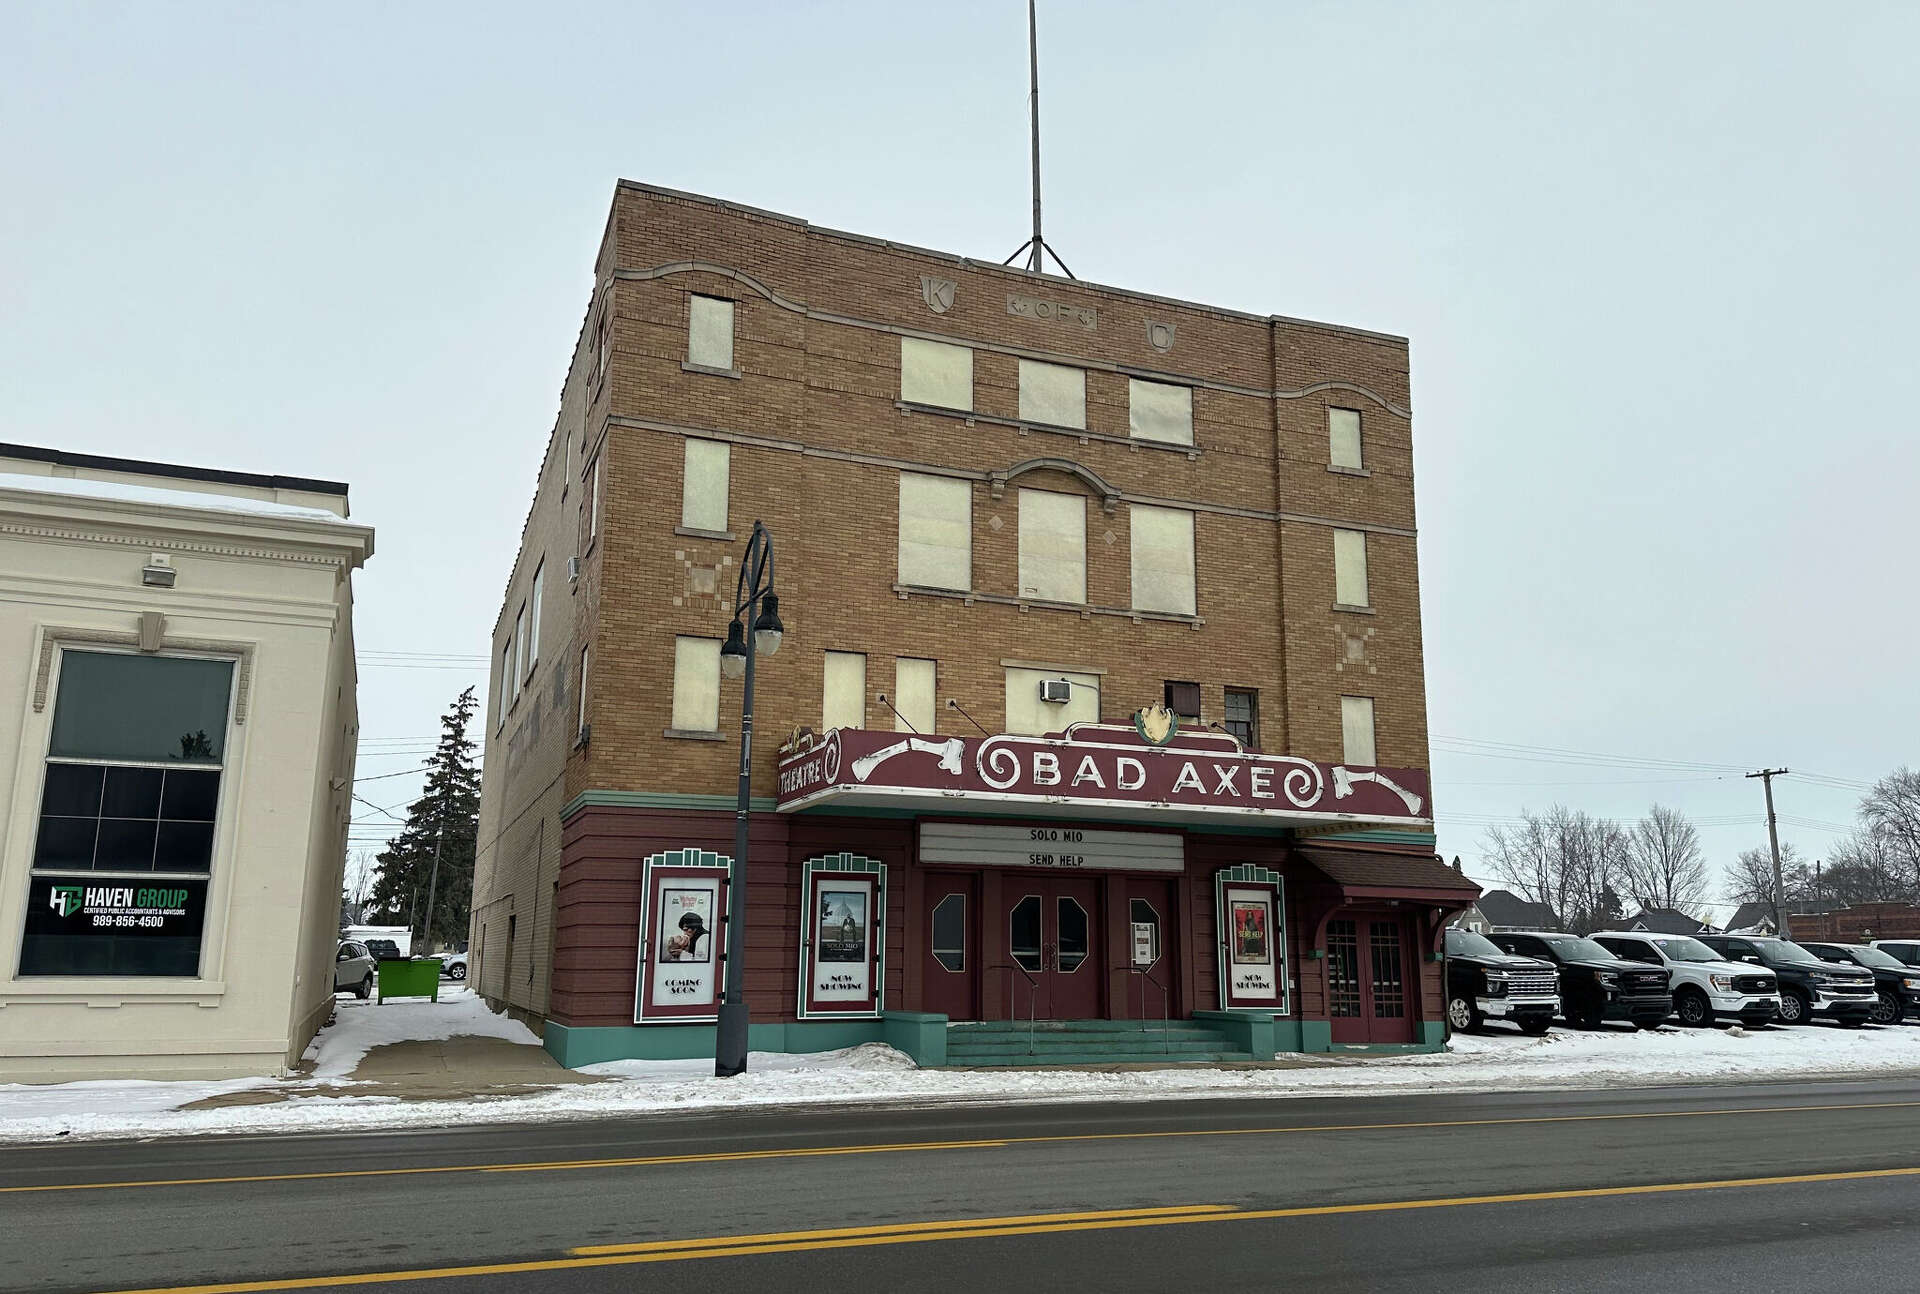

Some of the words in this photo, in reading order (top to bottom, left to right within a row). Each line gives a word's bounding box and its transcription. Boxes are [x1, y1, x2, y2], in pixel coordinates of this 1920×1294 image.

[929, 278, 951, 309] K
[1036, 303, 1071, 321] OF
[781, 758, 821, 796] THEATRE
[1033, 751, 1147, 791] BAD
[1171, 761, 1275, 799] AXE
[1030, 829, 1057, 841] SOLO
[1063, 830, 1083, 842] MIO
[1029, 854, 1054, 865] SEND
[1060, 855, 1084, 867] HELP
[85, 887, 134, 907] HAVEN
[136, 889, 189, 908] GROUP
[92, 915, 164, 927] 989-856-4500
[664, 979, 703, 987] COMING
